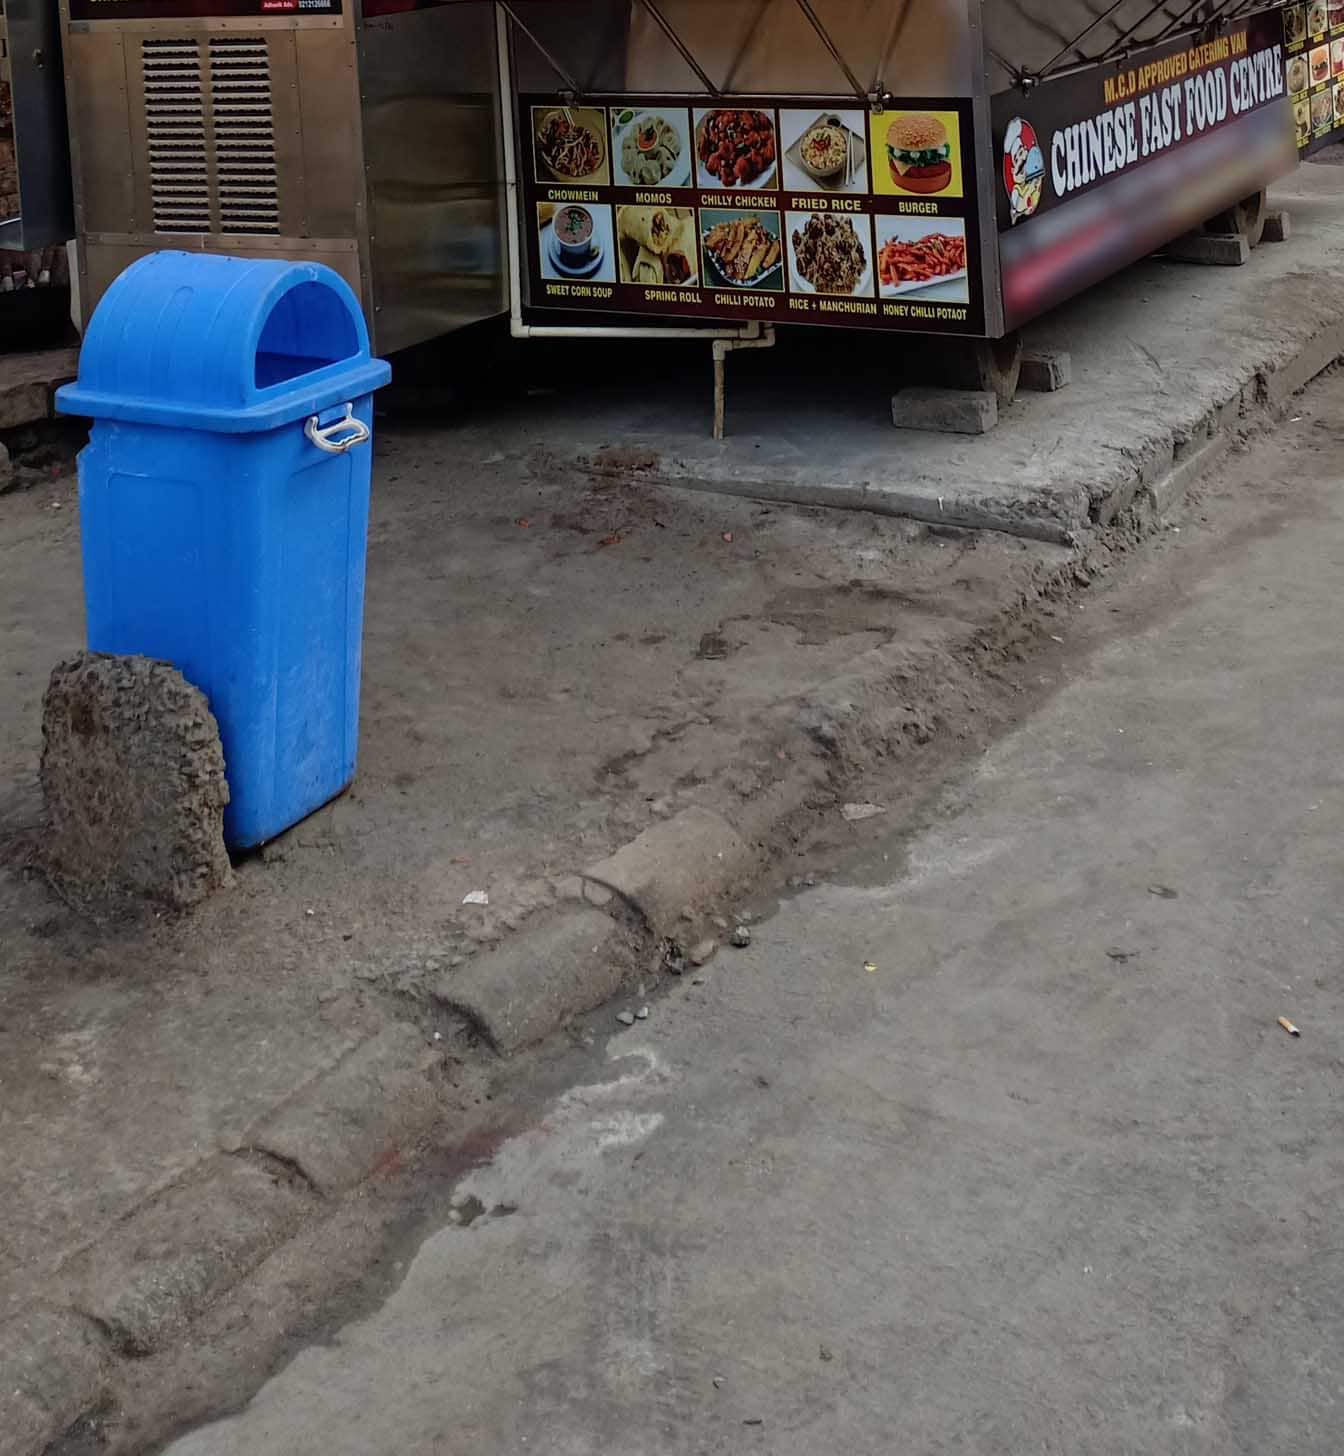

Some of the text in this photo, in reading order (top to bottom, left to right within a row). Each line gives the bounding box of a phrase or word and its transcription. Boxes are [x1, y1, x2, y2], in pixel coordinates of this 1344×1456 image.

[1104, 31, 1248, 103] M.C.D APPROVED CATERING VAN
[1050, 45, 1284, 197] CHINESE FAST FOOD CENTRE
[548, 189, 599, 201] CHOWMEIN
[635, 192, 672, 204] MOMOS
[701, 194, 777, 208] CHILLY CHICKEN
[792, 197, 862, 211] FRIED RICE
[899, 202, 938, 214] BURGER
[546, 285, 613, 298] SWEET CORN SOUP
[645, 290, 702, 303] SPRING ROLL
[714, 294, 775, 308] CHILLI POTATO
[789, 298, 809, 309] RICE
[819, 300, 877, 314] MANCHURIAN
[883, 303, 909, 316] HONEY
[910, 306, 936, 318] CHILLI
